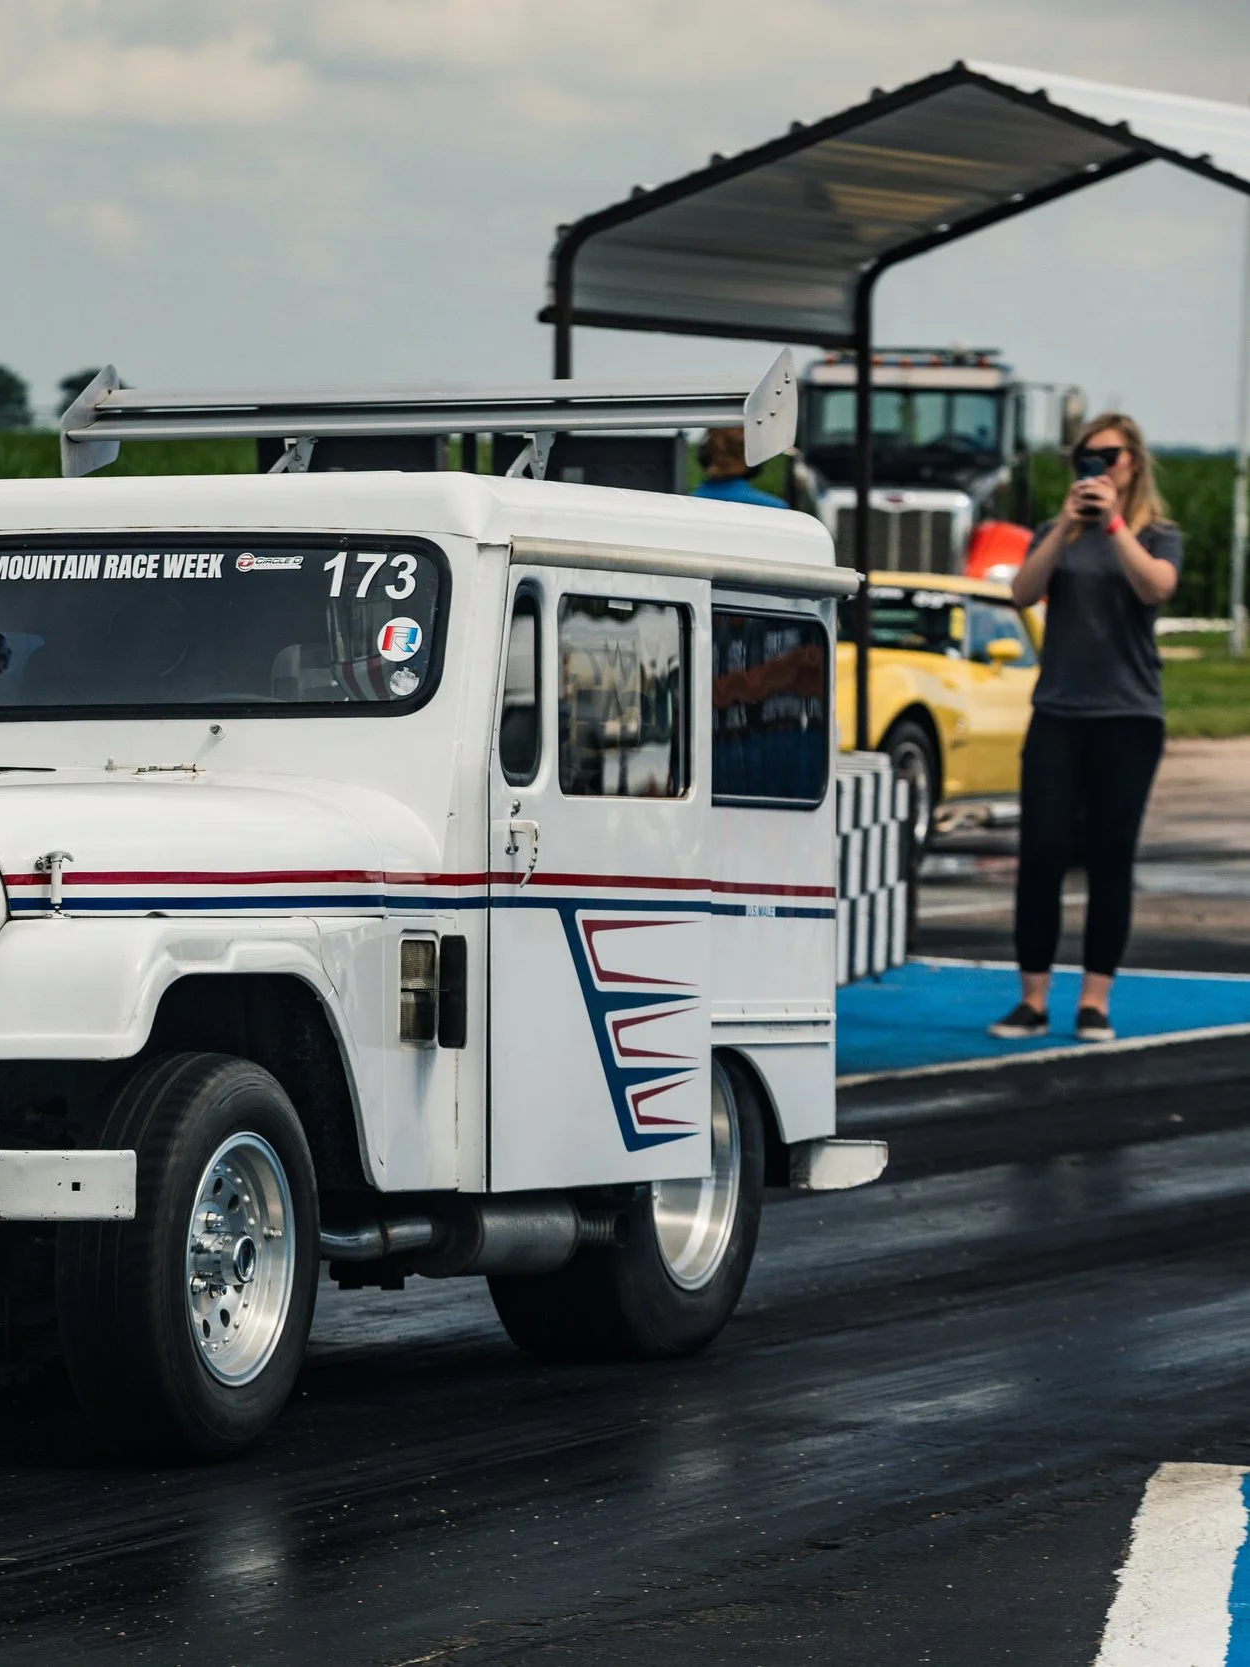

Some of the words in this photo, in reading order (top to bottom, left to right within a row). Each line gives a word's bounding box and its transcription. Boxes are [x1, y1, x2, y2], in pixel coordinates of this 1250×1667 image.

[103, 554, 160, 579] RACE
[163, 553, 225, 579] WEEK
[323, 551, 418, 600] 173
[381, 625, 419, 653] R
